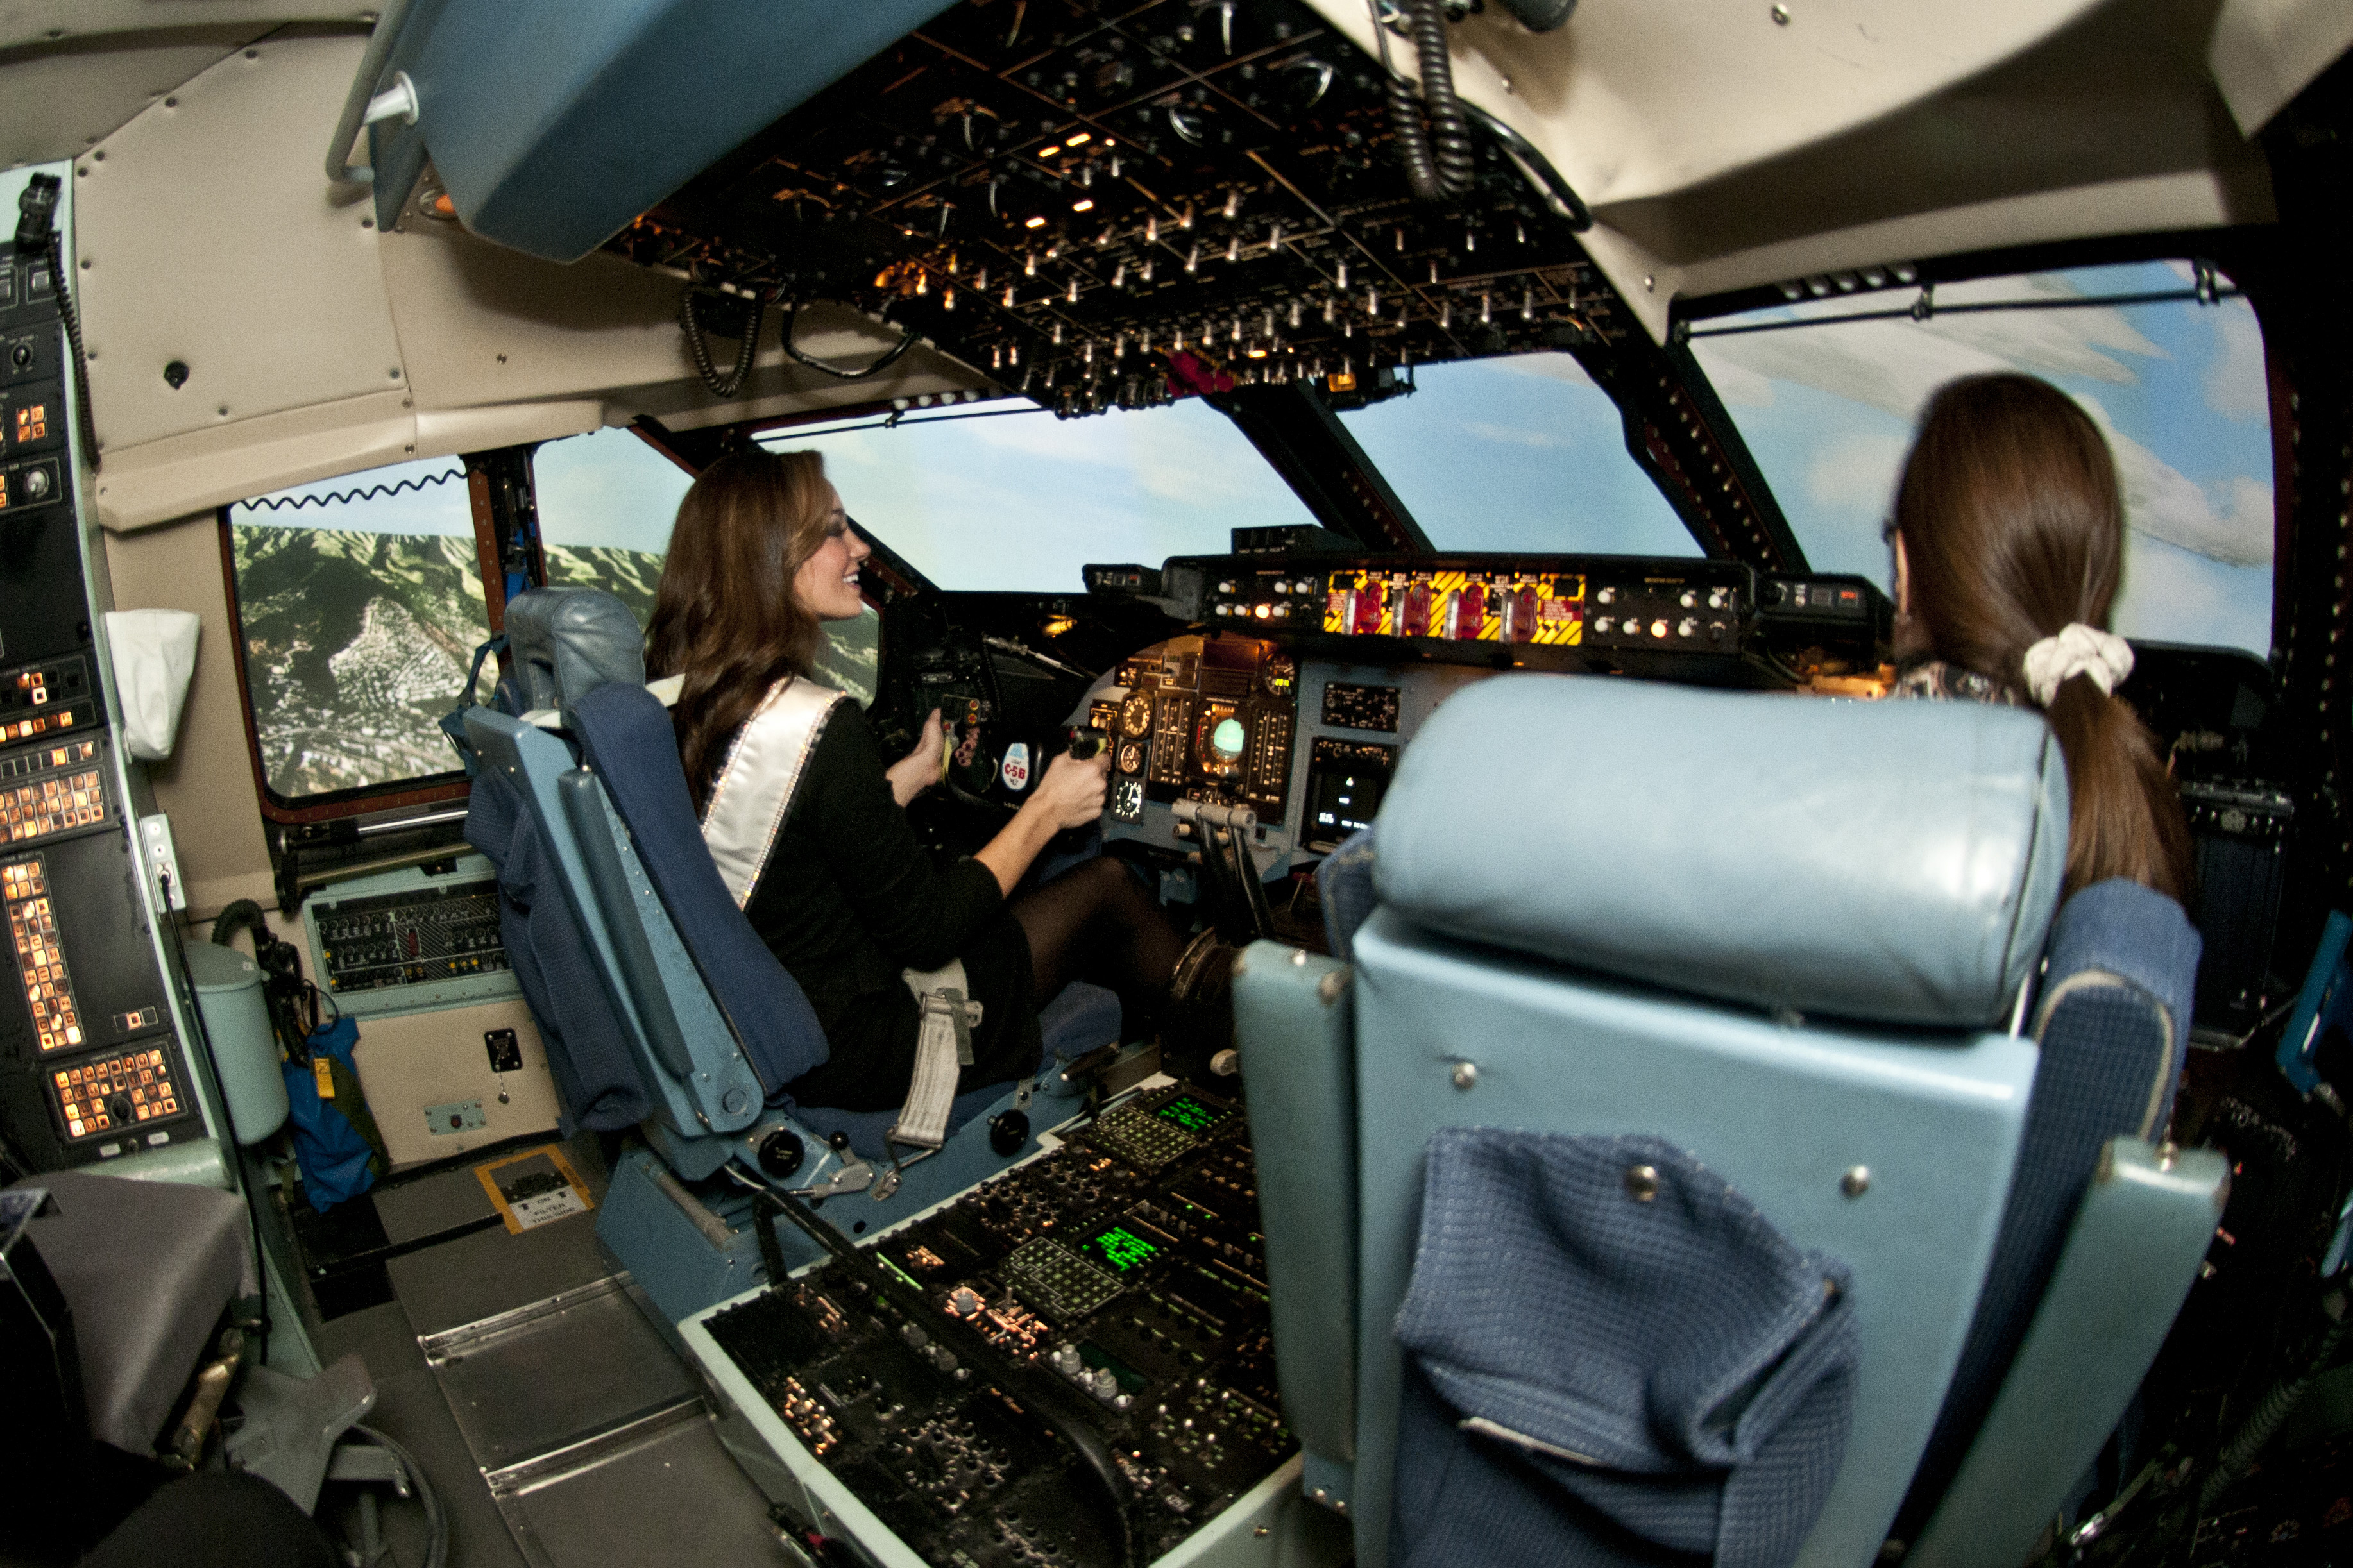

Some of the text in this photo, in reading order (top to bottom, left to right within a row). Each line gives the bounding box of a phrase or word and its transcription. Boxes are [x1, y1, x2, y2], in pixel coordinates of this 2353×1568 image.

[1005, 763, 1026, 779] C-5B
[532, 1206, 576, 1224] THIS SIDE
[534, 1202, 565, 1216] FILTER
